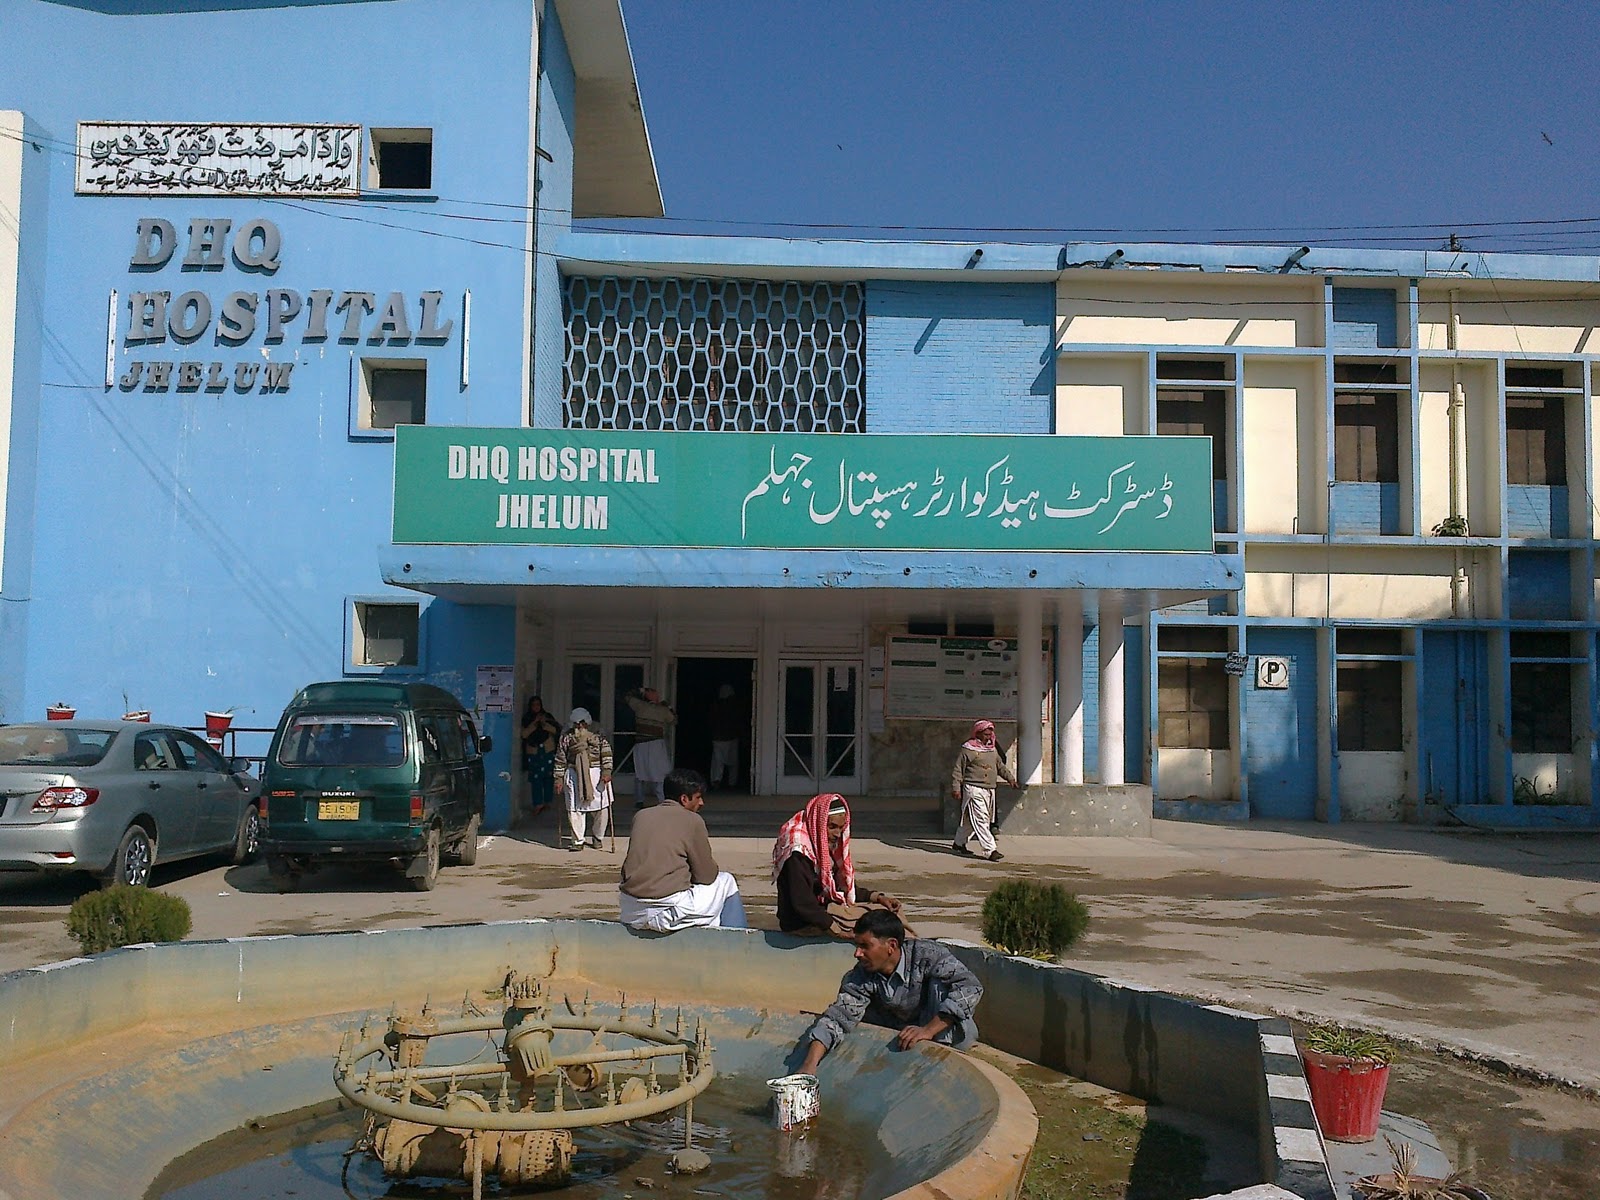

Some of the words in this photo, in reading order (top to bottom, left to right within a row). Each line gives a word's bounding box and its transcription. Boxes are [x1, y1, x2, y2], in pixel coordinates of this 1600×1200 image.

[129, 218, 281, 272] DHQ
[126, 288, 454, 343] HOSPITAL
[120, 361, 294, 390] JHELUM
[447, 445, 510, 484] DHQ
[517, 446, 660, 483] HOSPITAL
[741, 443, 813, 540] جہلم
[495, 494, 609, 530] JHELUM
[808, 458, 918, 529] ہسپتال
[1043, 460, 1174, 535] ڈسٹرکٹ
[1267, 661, 1280, 683] P
